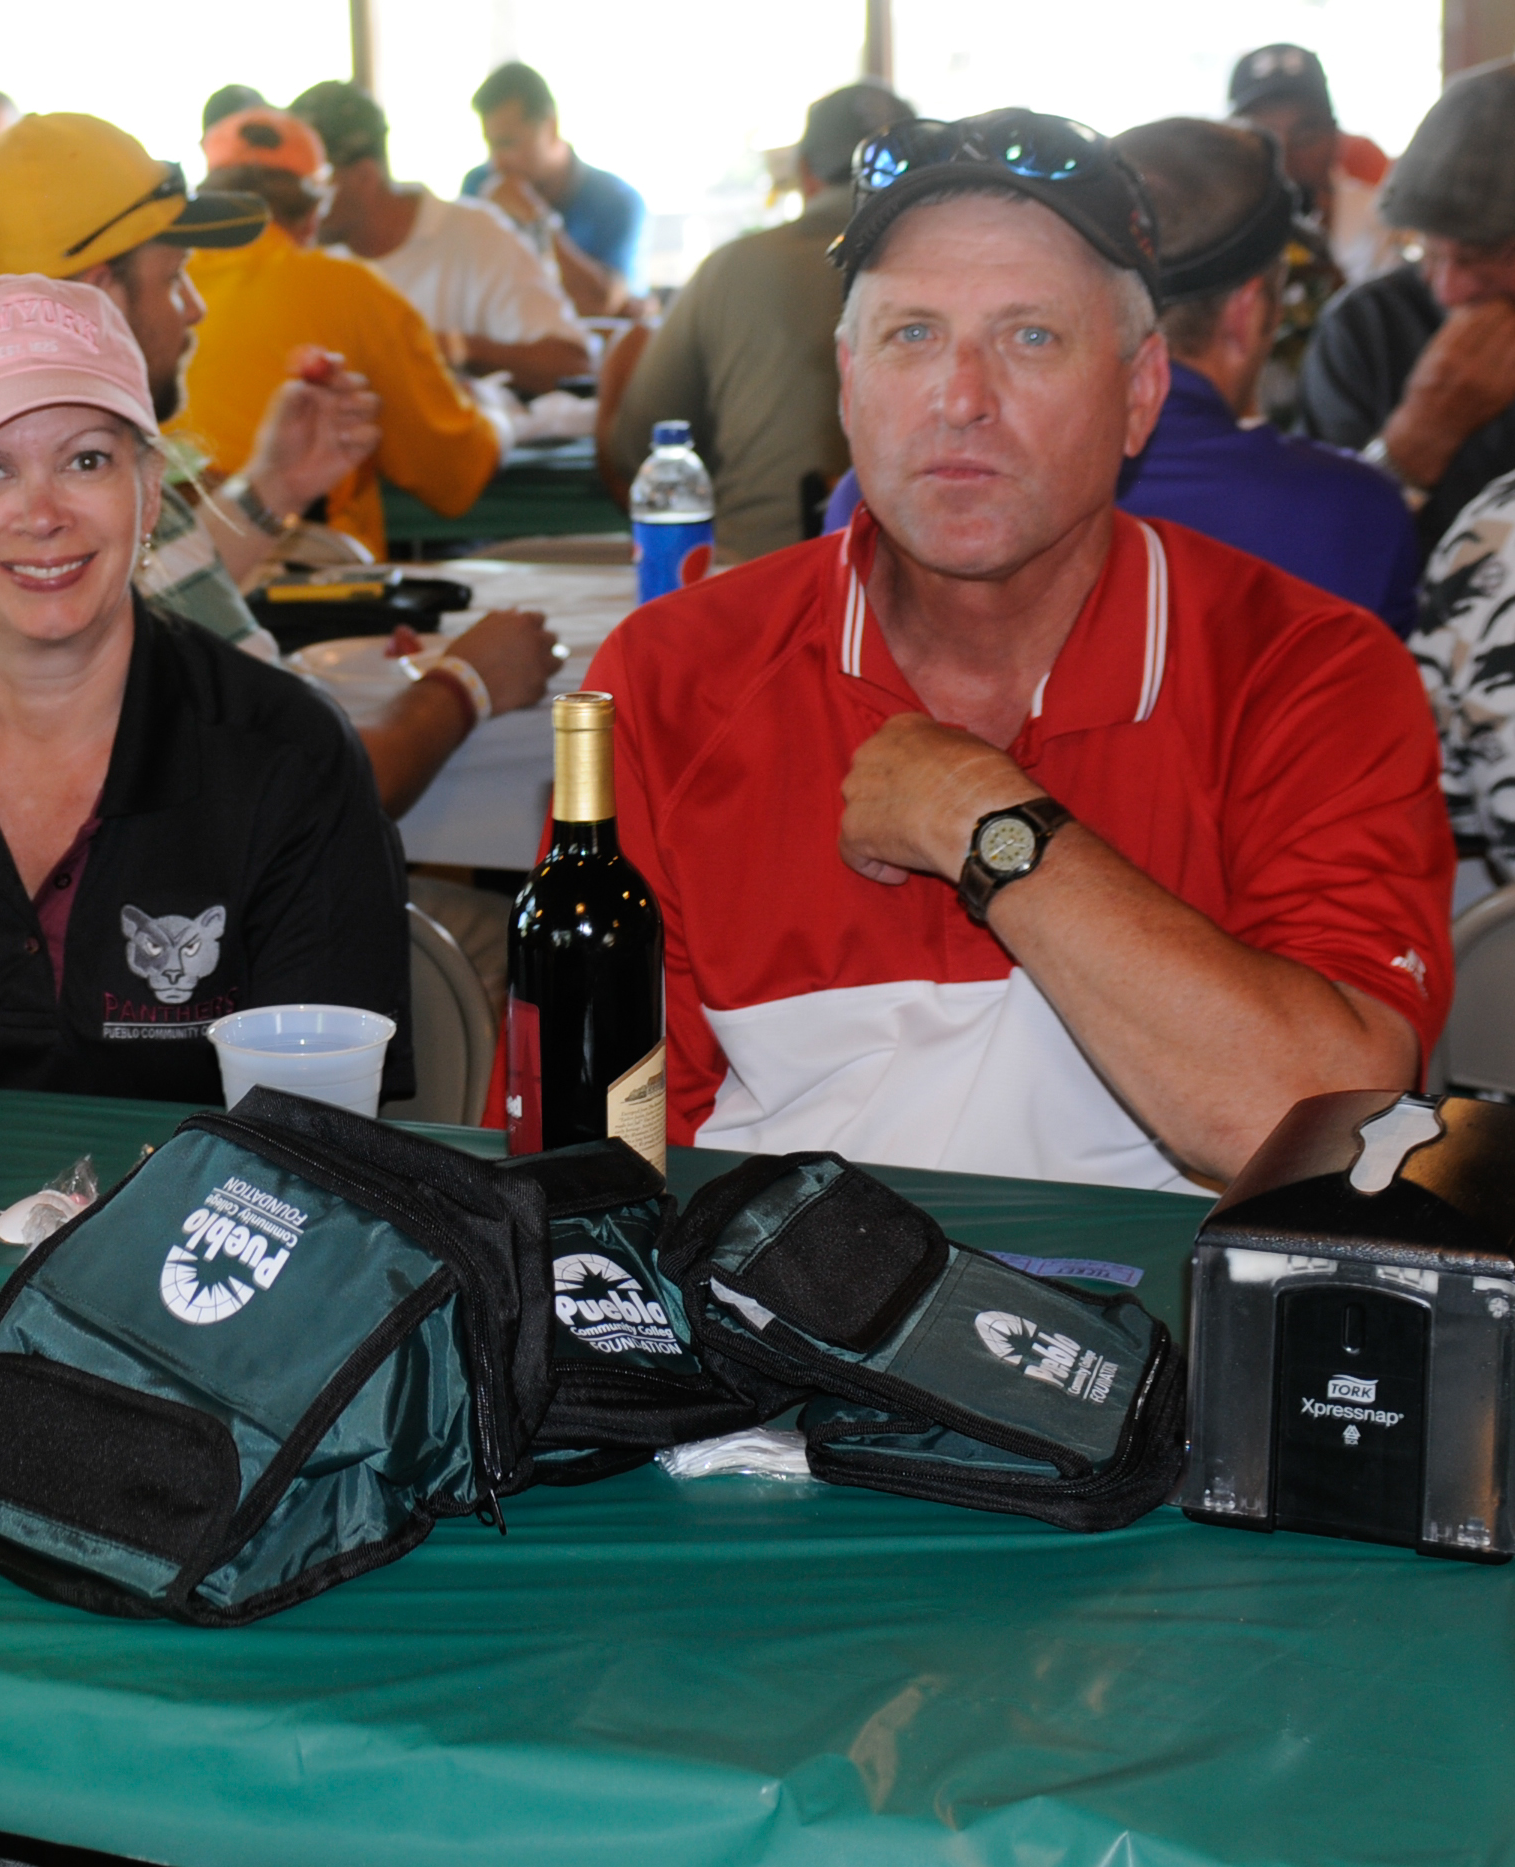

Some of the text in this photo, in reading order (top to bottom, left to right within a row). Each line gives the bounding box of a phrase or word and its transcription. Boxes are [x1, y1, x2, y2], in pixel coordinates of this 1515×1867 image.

[12, 299, 102, 356] YORK
[103, 986, 240, 1022] PANTHERS
[103, 1026, 139, 1039] PUEBLO
[140, 1026, 199, 1040] COMMUNITY
[223, 1176, 309, 1227] FOUNDATION
[204, 1193, 299, 1249] Community College
[183, 1208, 291, 1291] Pueblo
[555, 1290, 669, 1326] Pueblo
[569, 1322, 675, 1339] Community Colleg
[1067, 1367, 1092, 1395] Commty
[1332, 1383, 1374, 1399] TORK
[1301, 1397, 1399, 1427] Xpressnap
